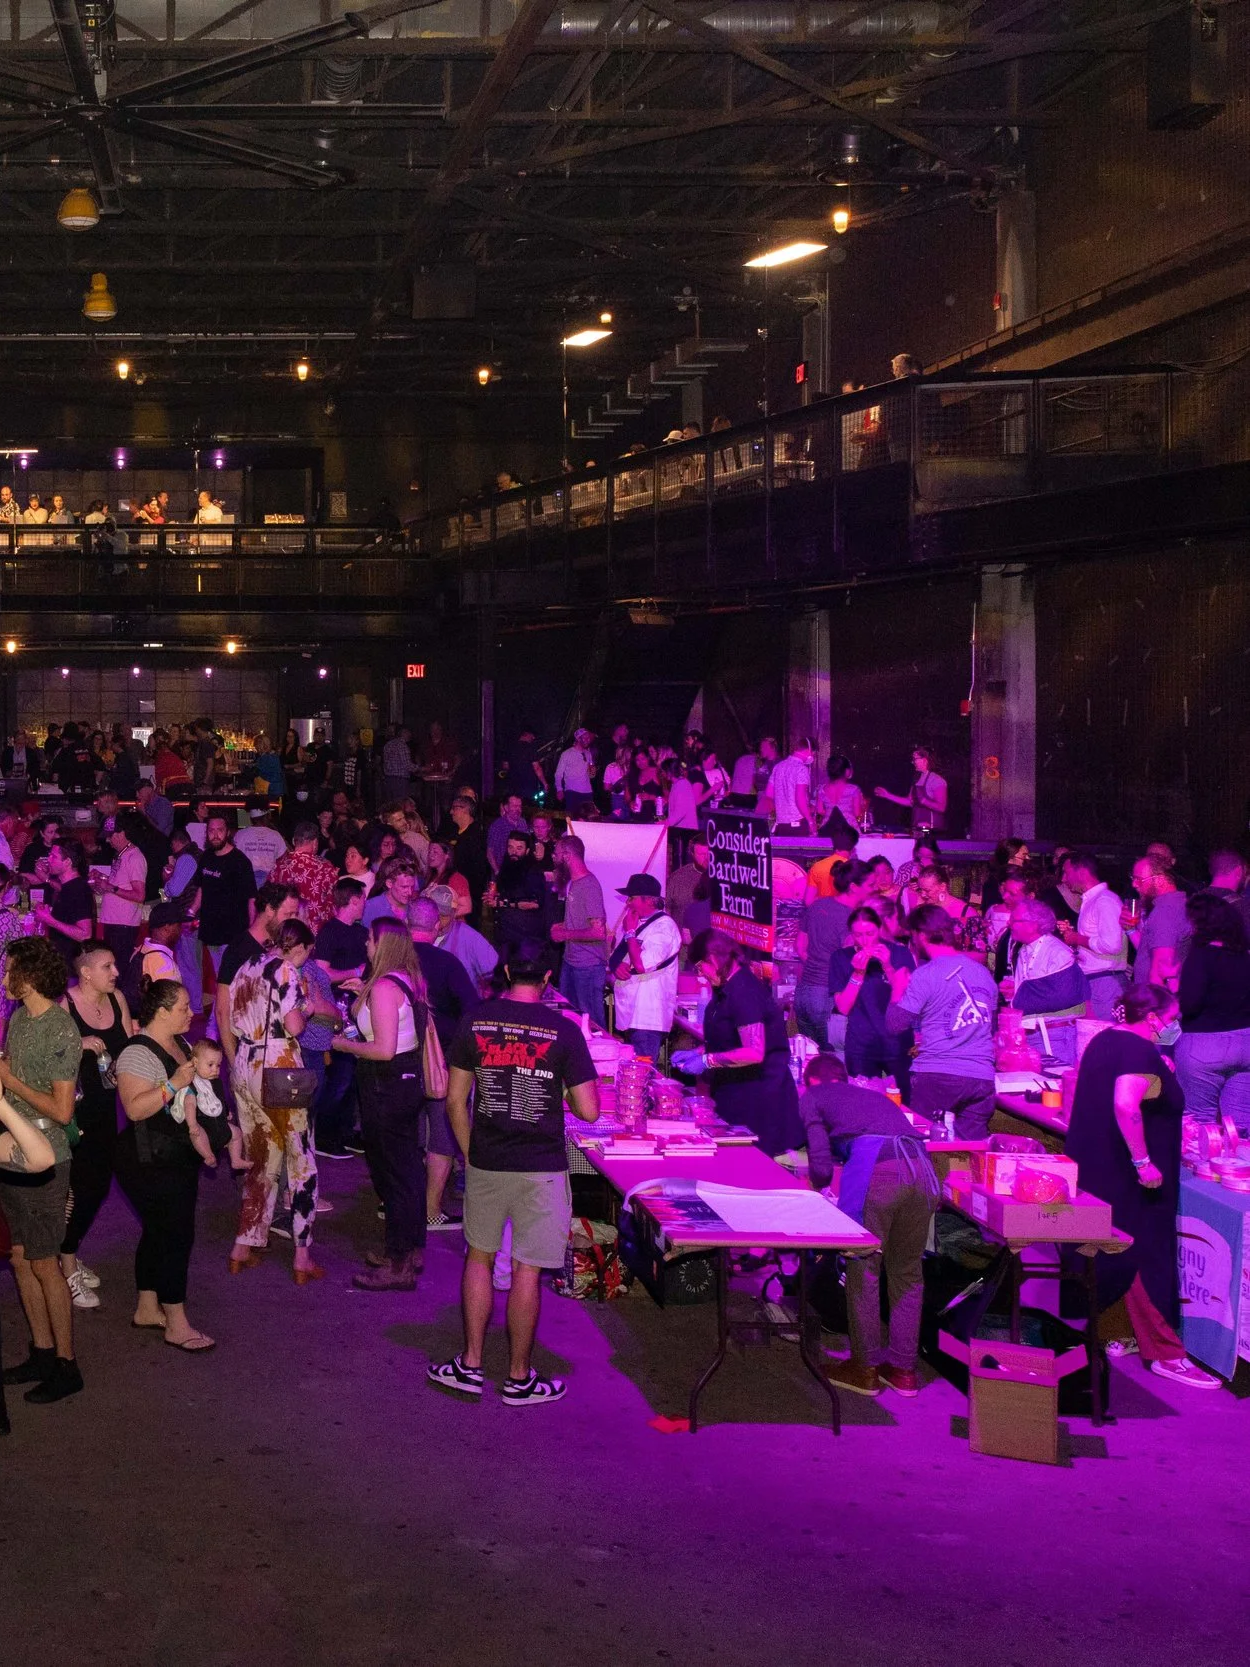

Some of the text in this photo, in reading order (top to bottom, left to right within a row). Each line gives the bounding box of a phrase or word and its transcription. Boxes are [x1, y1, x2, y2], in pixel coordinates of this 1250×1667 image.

[796, 363, 805, 384] EXIT
[407, 664, 425, 678] EXIT
[707, 819, 769, 856] Consider
[708, 851, 770, 890] Bardwell
[719, 883, 755, 919] Farm
[739, 921, 769, 938] CHEESES
[516, 1066, 554, 1079] THE END
[1178, 1245, 1206, 1277] gny
